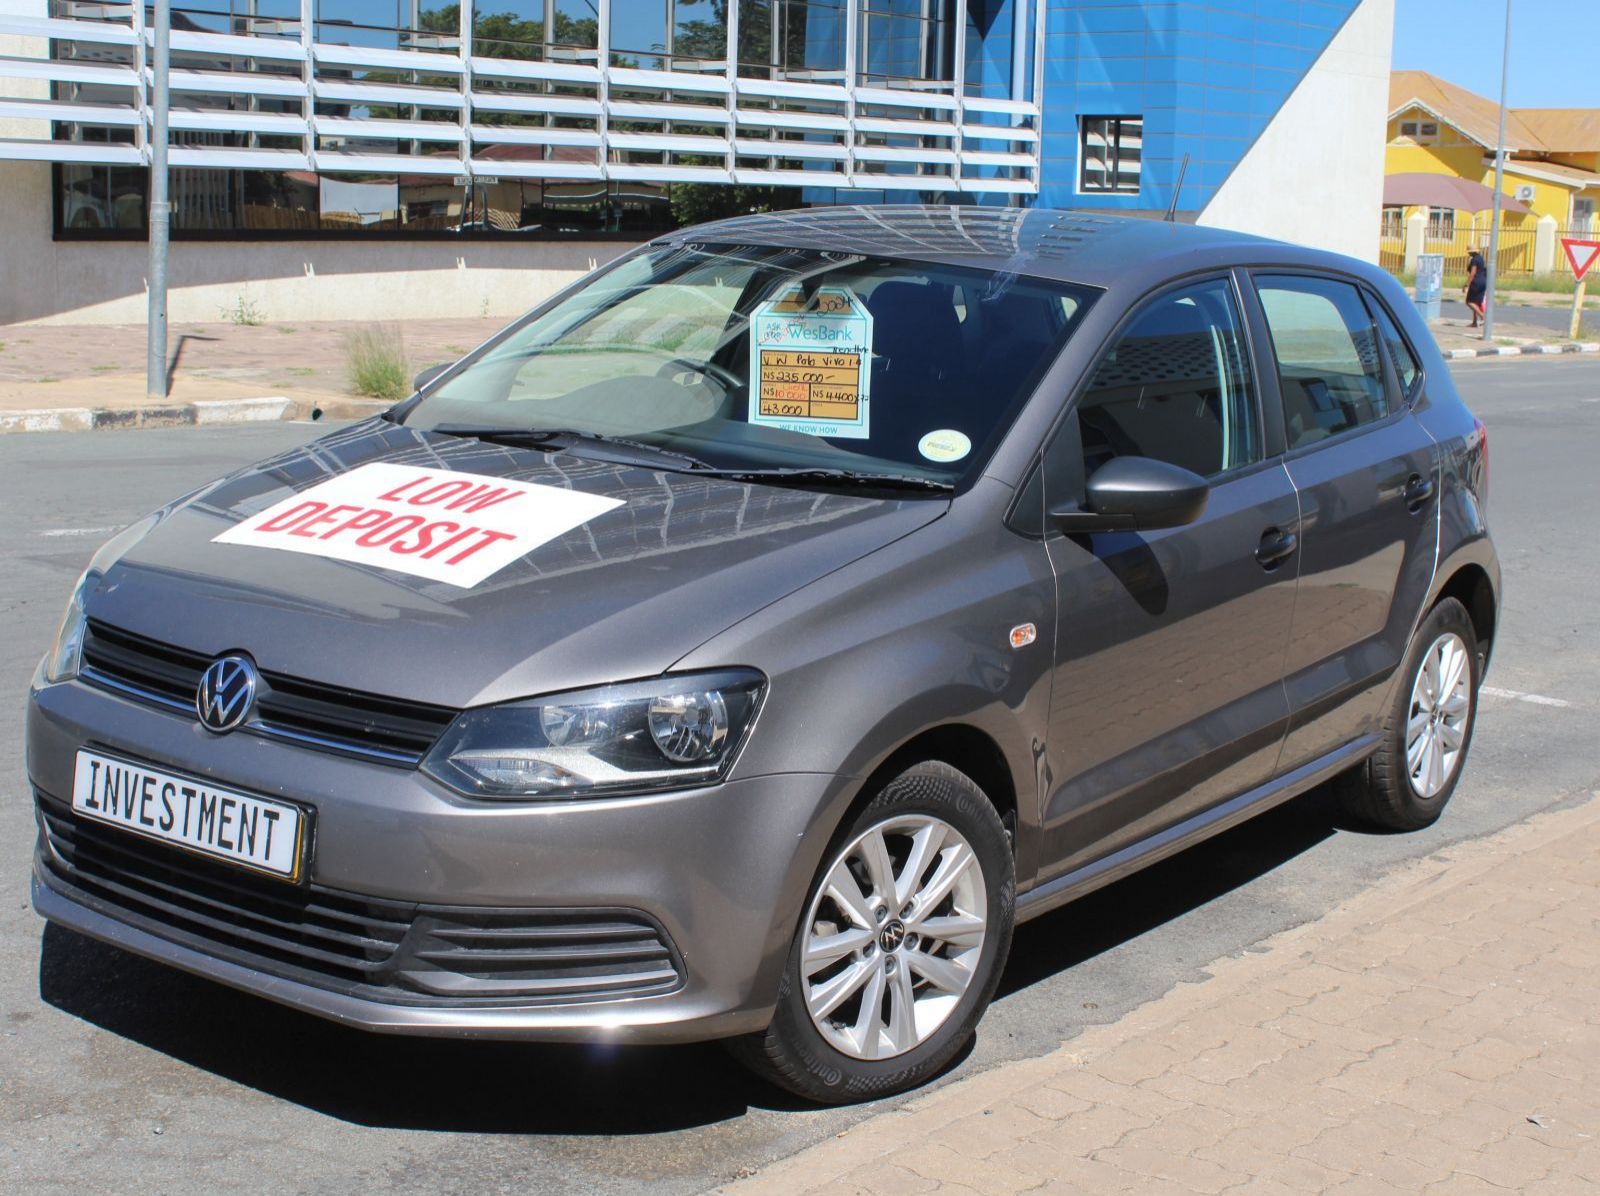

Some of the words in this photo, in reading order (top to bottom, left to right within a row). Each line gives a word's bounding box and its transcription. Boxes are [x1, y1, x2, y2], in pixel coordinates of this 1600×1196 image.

[787, 323, 853, 341] WesBank
[793, 424, 818, 433] KNOW
[819, 426, 838, 434] HOW
[377, 475, 527, 515] LOW
[254, 500, 518, 566] DEPOSIT
[85, 760, 281, 861] INVESTMENT
